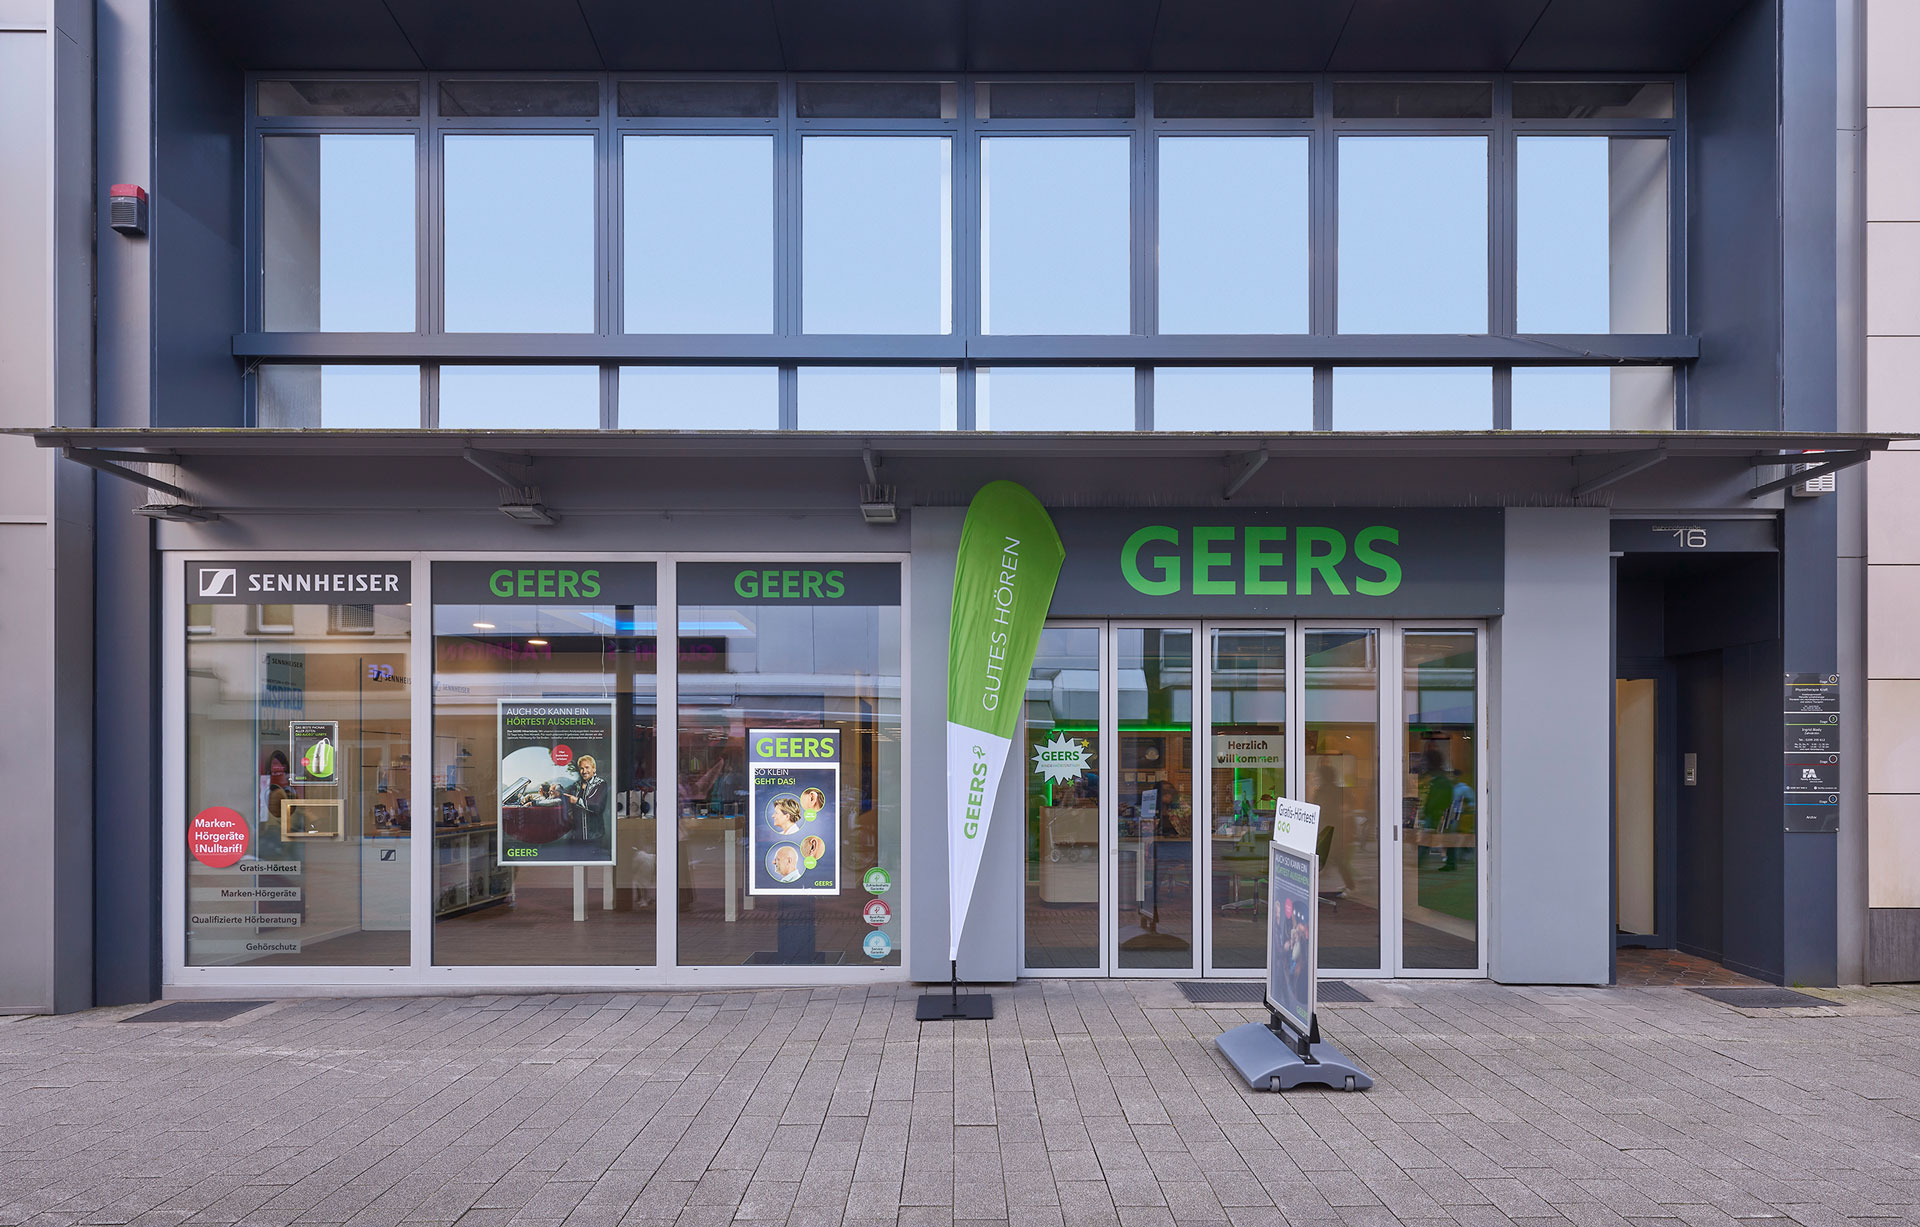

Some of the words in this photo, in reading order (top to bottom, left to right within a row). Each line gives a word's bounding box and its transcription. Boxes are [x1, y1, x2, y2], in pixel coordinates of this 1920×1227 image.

[1673, 530, 1706, 547] 16
[1120, 525, 1402, 596] GEERS
[248, 573, 400, 592] SENNHEISER
[489, 569, 601, 598] GEERS
[734, 570, 845, 599] GEERS
[993, 536, 1021, 625] HÖREN
[982, 631, 1007, 711] GUTES
[506, 707, 531, 716] AUCH
[533, 707, 546, 716] SO
[547, 707, 573, 716] KANN
[575, 707, 589, 716] EIN
[506, 716, 546, 726] HÖRTEST
[547, 717, 597, 726] AUSSEHEN.
[756, 737, 835, 758] GEERS
[1227, 740, 1268, 750] Herzlich
[1041, 751, 1080, 761] GEERS
[1216, 753, 1279, 764] willkommen
[754, 768, 766, 776] SO
[767, 768, 789, 776] KLEIN
[1802, 768, 1817, 778] FA
[754, 777, 776, 785] GEHT
[777, 777, 796, 785] DAS!
[963, 762, 988, 840] GEERS
[1279, 803, 1316, 825] Gratis-Hörtest!
[195, 818, 236, 828] Marken-
[195, 831, 245, 843] Hörgeräte
[199, 843, 243, 853] Nulltarif!
[507, 848, 538, 857] GEERS
[239, 863, 297, 872] Gratis-Hörtest
[221, 889, 297, 898] Marken-Hörgeräte
[191, 914, 243, 924] Qualifizierte
[244, 914, 297, 925] Hörberatung
[245, 943, 297, 951] Gehörschutz
